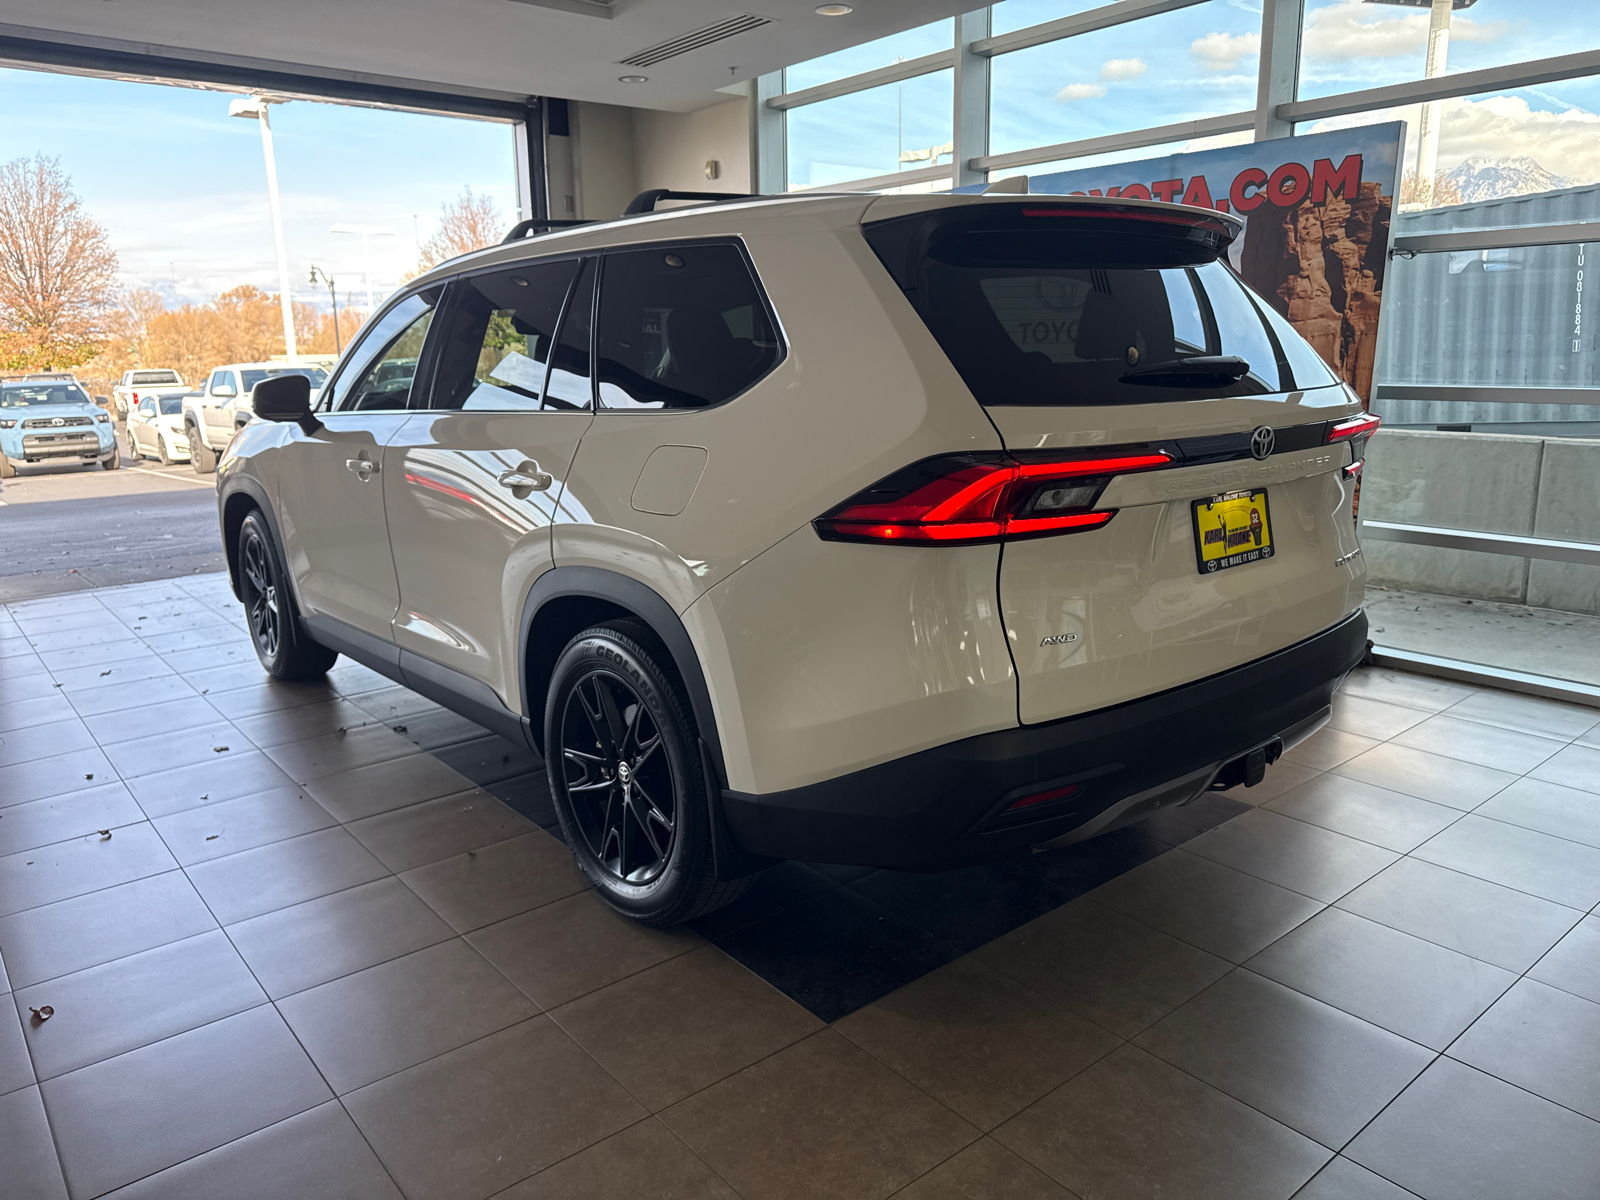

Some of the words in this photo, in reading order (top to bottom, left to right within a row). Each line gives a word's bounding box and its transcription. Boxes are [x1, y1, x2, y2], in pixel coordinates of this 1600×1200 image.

[1251, 513, 1259, 523] 32
[1220, 558, 1229, 568] WE
[1229, 554, 1243, 566] MAKE
[1242, 553, 1249, 562] IT
[1248, 550, 1260, 561] EASY
[1040, 633, 1077, 647] AWD
